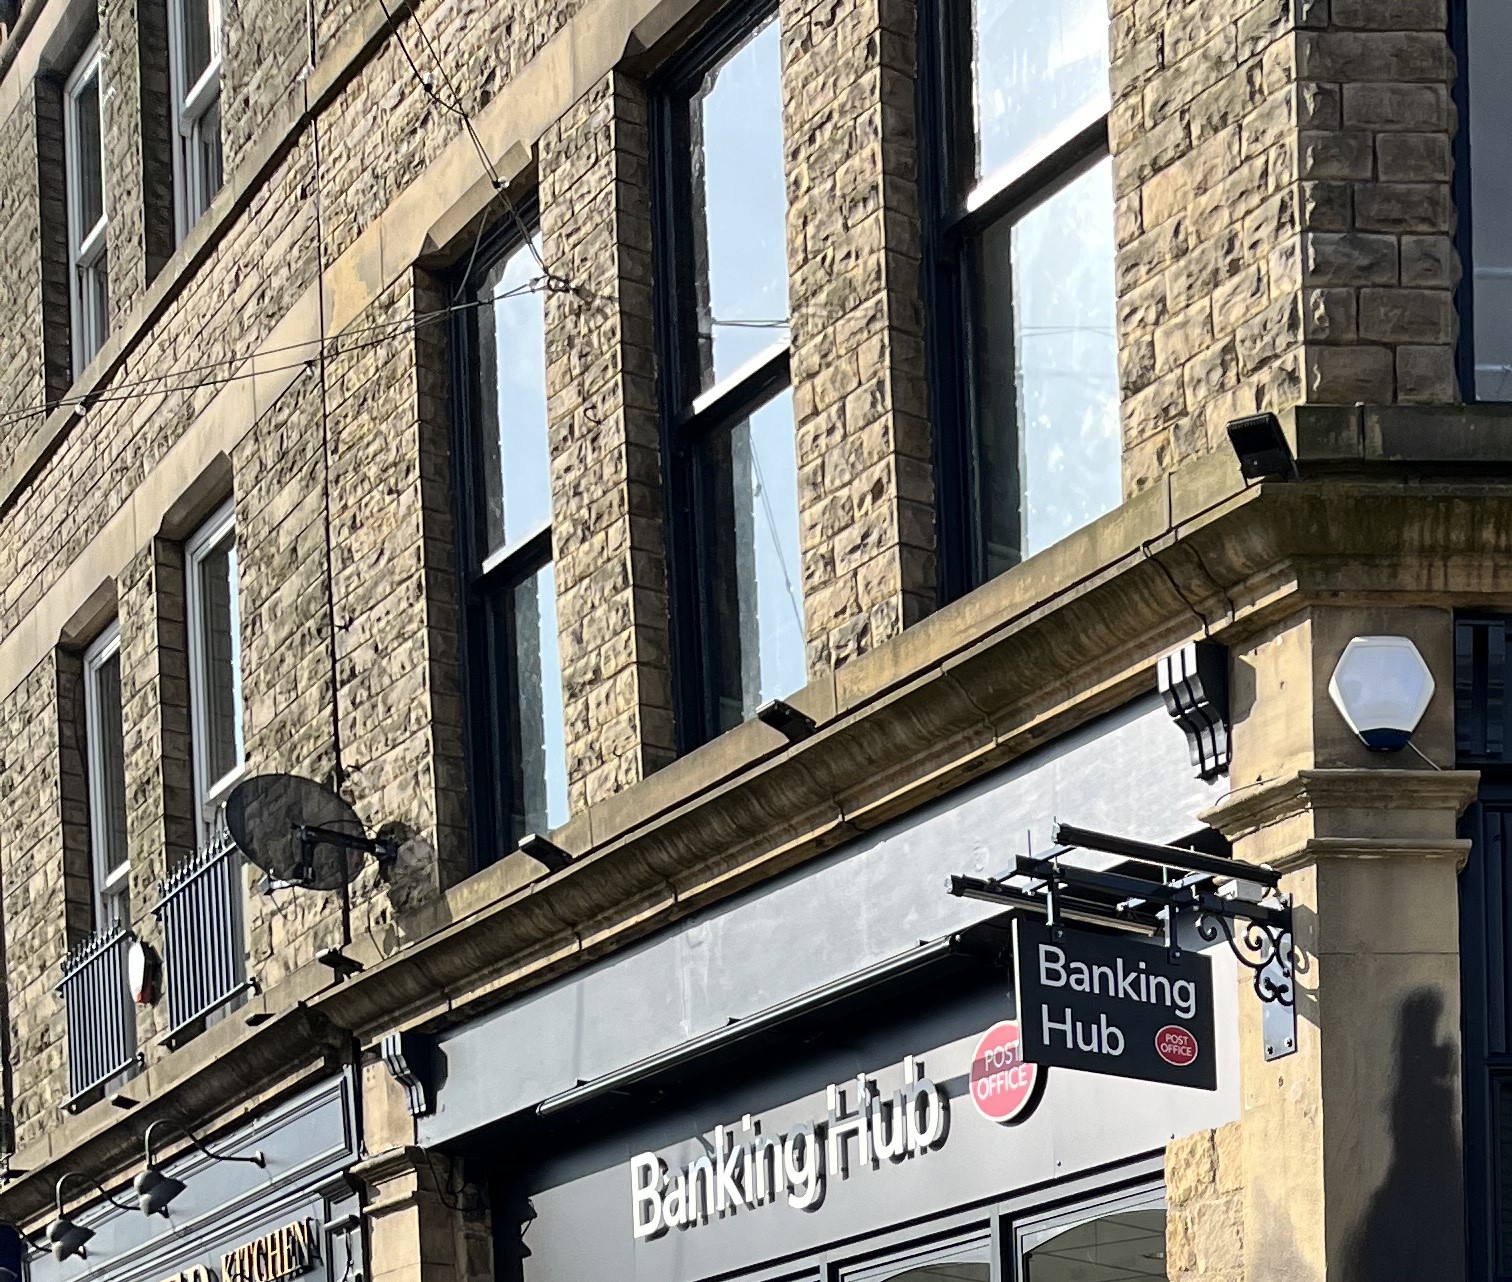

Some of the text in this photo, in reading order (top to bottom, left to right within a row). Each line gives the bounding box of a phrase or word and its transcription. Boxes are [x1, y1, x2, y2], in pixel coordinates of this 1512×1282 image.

[1039, 942, 1197, 1020] Banking
[1040, 1003, 1126, 1058] Hub
[1159, 1041, 1193, 1059] OFFICE
[1164, 1033, 1189, 1048] POST
[984, 1040, 1020, 1072] POST
[976, 1062, 1028, 1101] OFFICE
[630, 1055, 942, 1240] Banking Hub
